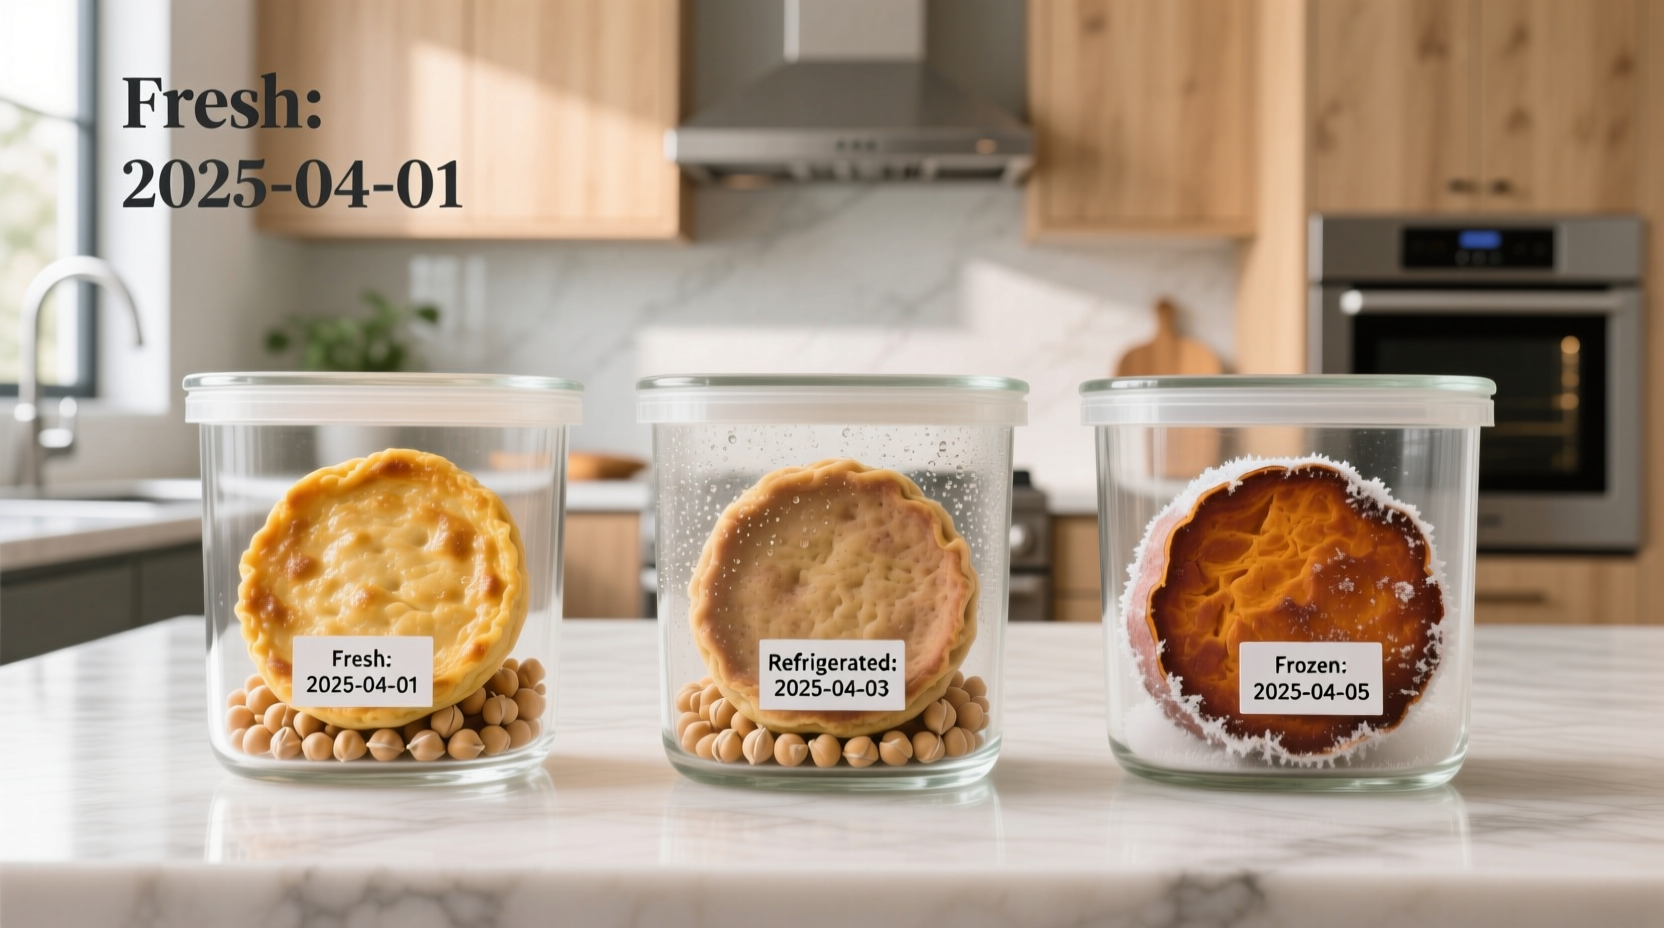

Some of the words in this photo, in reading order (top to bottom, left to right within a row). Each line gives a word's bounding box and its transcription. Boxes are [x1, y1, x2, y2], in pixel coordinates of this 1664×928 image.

[332, 648, 392, 668] Fresh:
[768, 652, 897, 676] Refrigerated:
[1275, 655, 1347, 674] Frozen:
[306, 675, 417, 694] 2025-04-01
[774, 679, 889, 698] 2025-04-03
[1253, 682, 1370, 701] 2025-04-05
